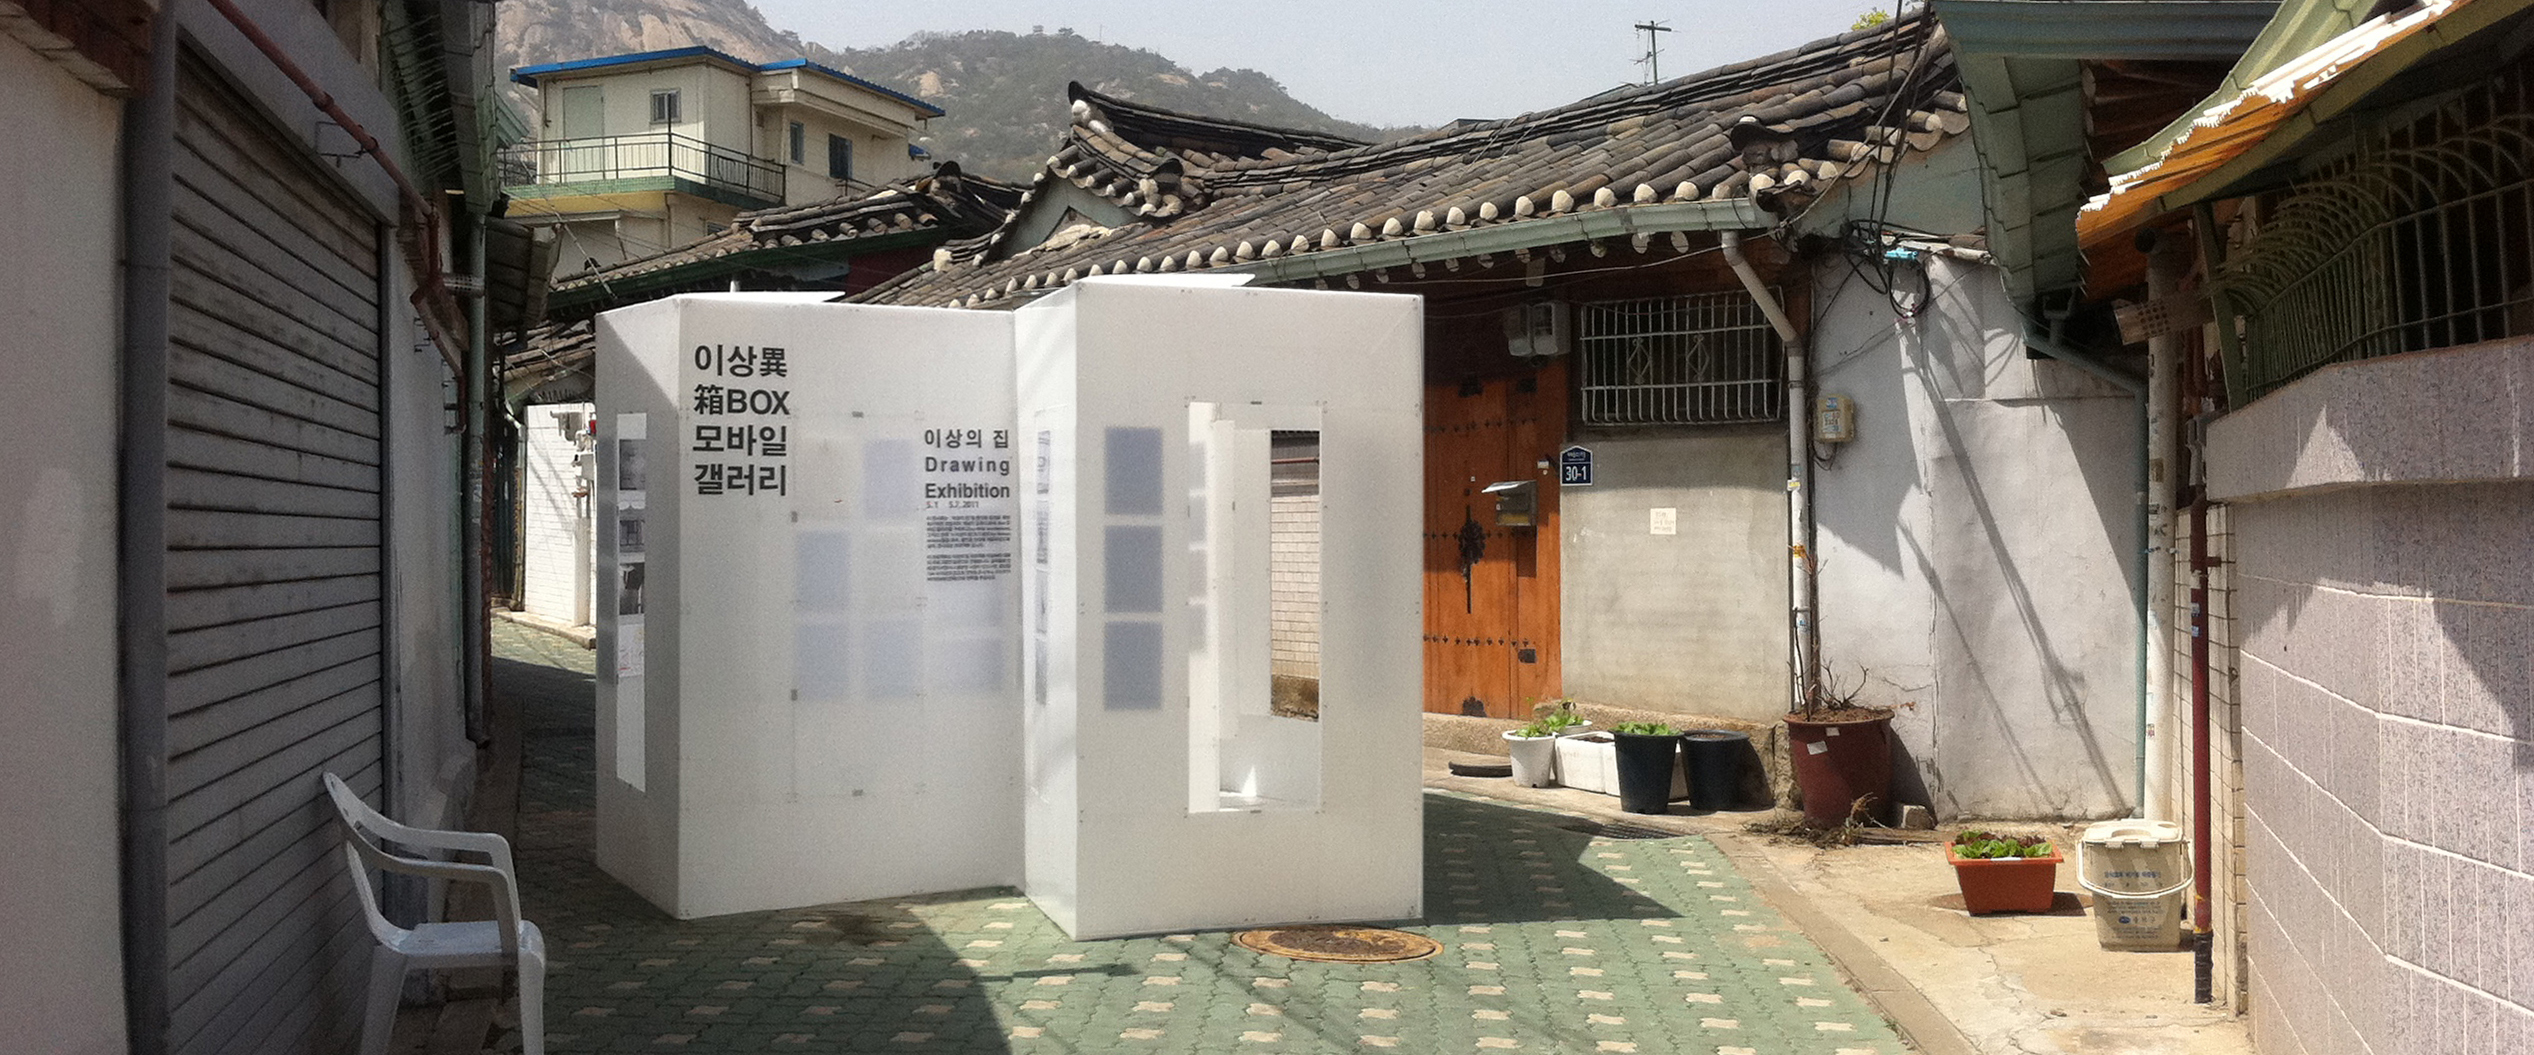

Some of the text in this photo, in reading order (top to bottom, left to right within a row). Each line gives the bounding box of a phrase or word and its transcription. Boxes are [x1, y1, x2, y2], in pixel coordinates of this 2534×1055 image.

[694, 344, 788, 378] 이상異
[694, 383, 791, 416] 箱BOX
[693, 424, 788, 457] 모바일
[924, 428, 1009, 449] 이상의 집
[694, 463, 787, 497] 갤러리
[925, 456, 1010, 477] Drawing
[1565, 465, 1587, 481] 30-1
[925, 482, 1011, 499] Exhibition
